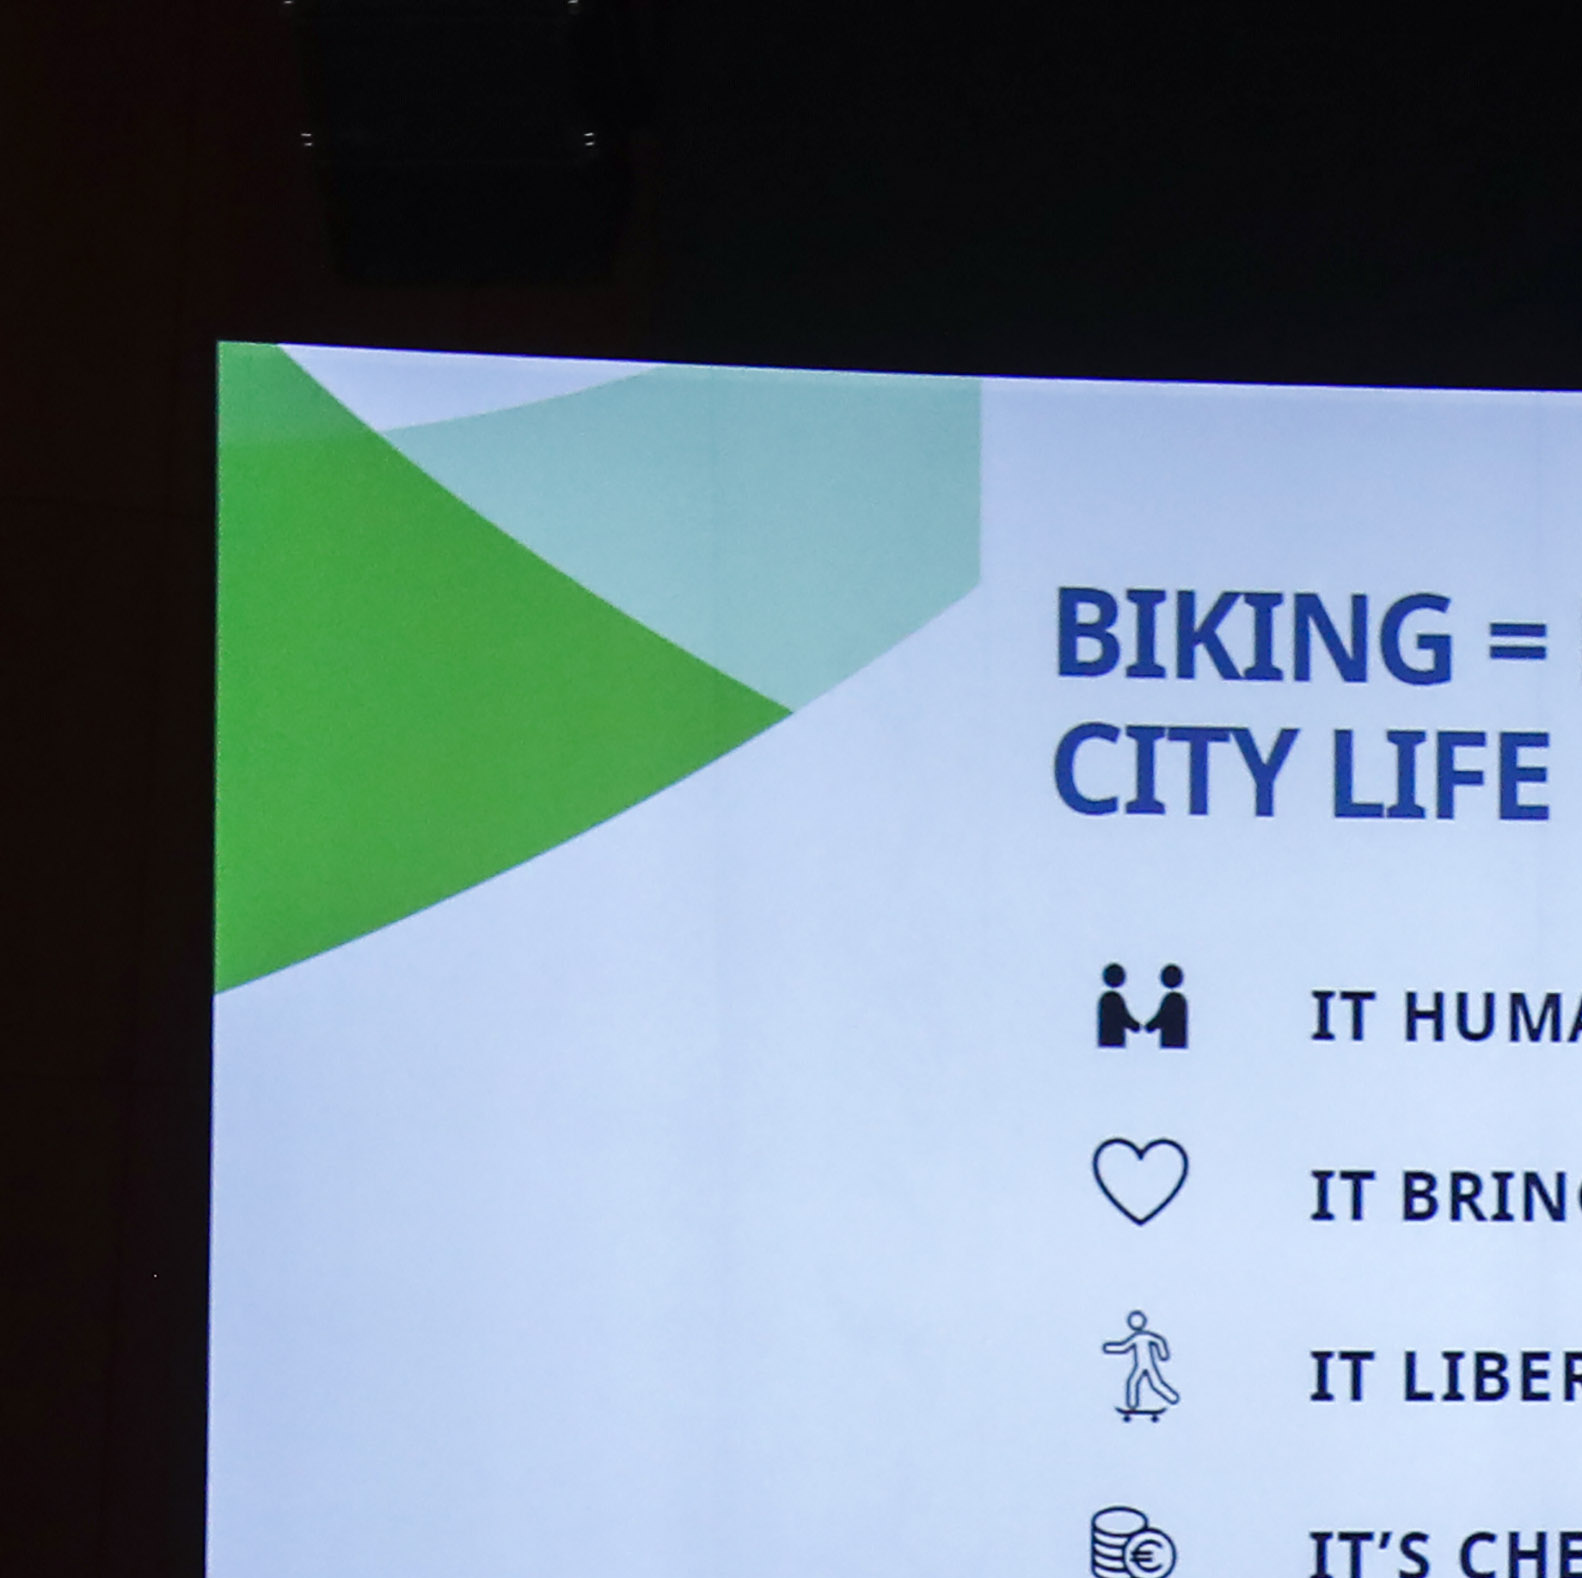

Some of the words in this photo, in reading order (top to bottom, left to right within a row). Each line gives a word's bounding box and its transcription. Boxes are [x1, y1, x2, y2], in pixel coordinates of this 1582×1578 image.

[1058, 587, 1452, 686] BIKING
[1490, 623, 1547, 660] =
[1054, 722, 1301, 817] CITY
[1334, 729, 1550, 821] LIFE
[1311, 990, 1377, 1042] IT
[1310, 1170, 1376, 1221] IT
[1310, 1351, 1376, 1402] IT
